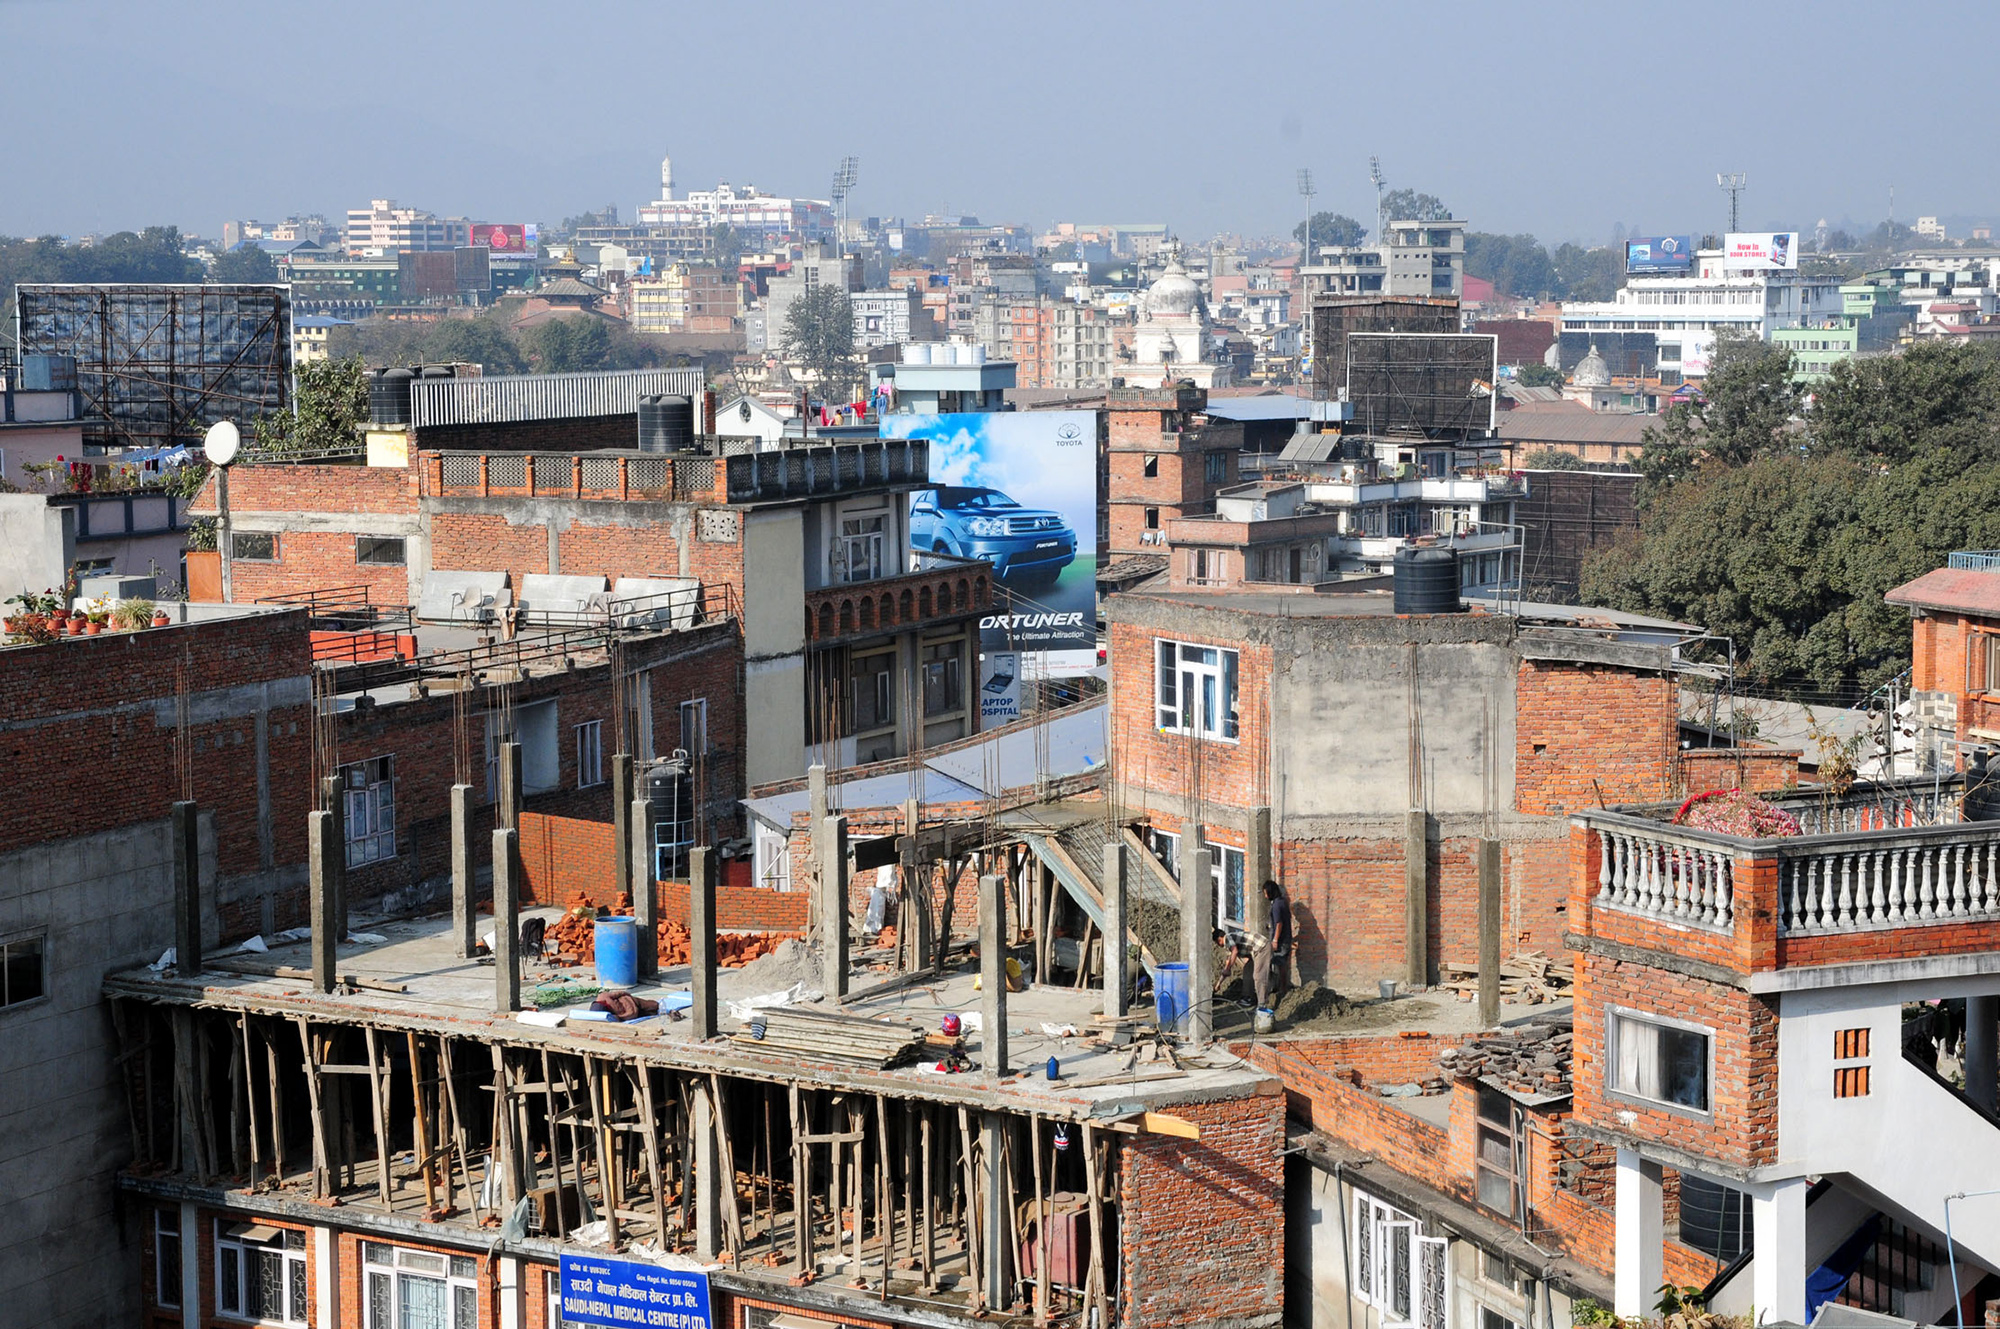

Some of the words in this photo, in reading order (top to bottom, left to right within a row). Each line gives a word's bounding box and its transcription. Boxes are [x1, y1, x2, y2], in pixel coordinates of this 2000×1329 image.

[979, 612, 1083, 630] ORTUNER
[1021, 632, 1050, 640] Ultimate
[1051, 630, 1085, 639] Attraction
[981, 698, 1013, 707] APTOP
[981, 707, 1019, 716] OSPITAL
[570, 1278, 593, 1293] साउदी
[564, 1297, 613, 1318] SAUDI-NEPAL
[613, 1305, 647, 1324] MEDICAL
[647, 1309, 680, 1328] CENTRE
[679, 1313, 691, 1329] (P)
